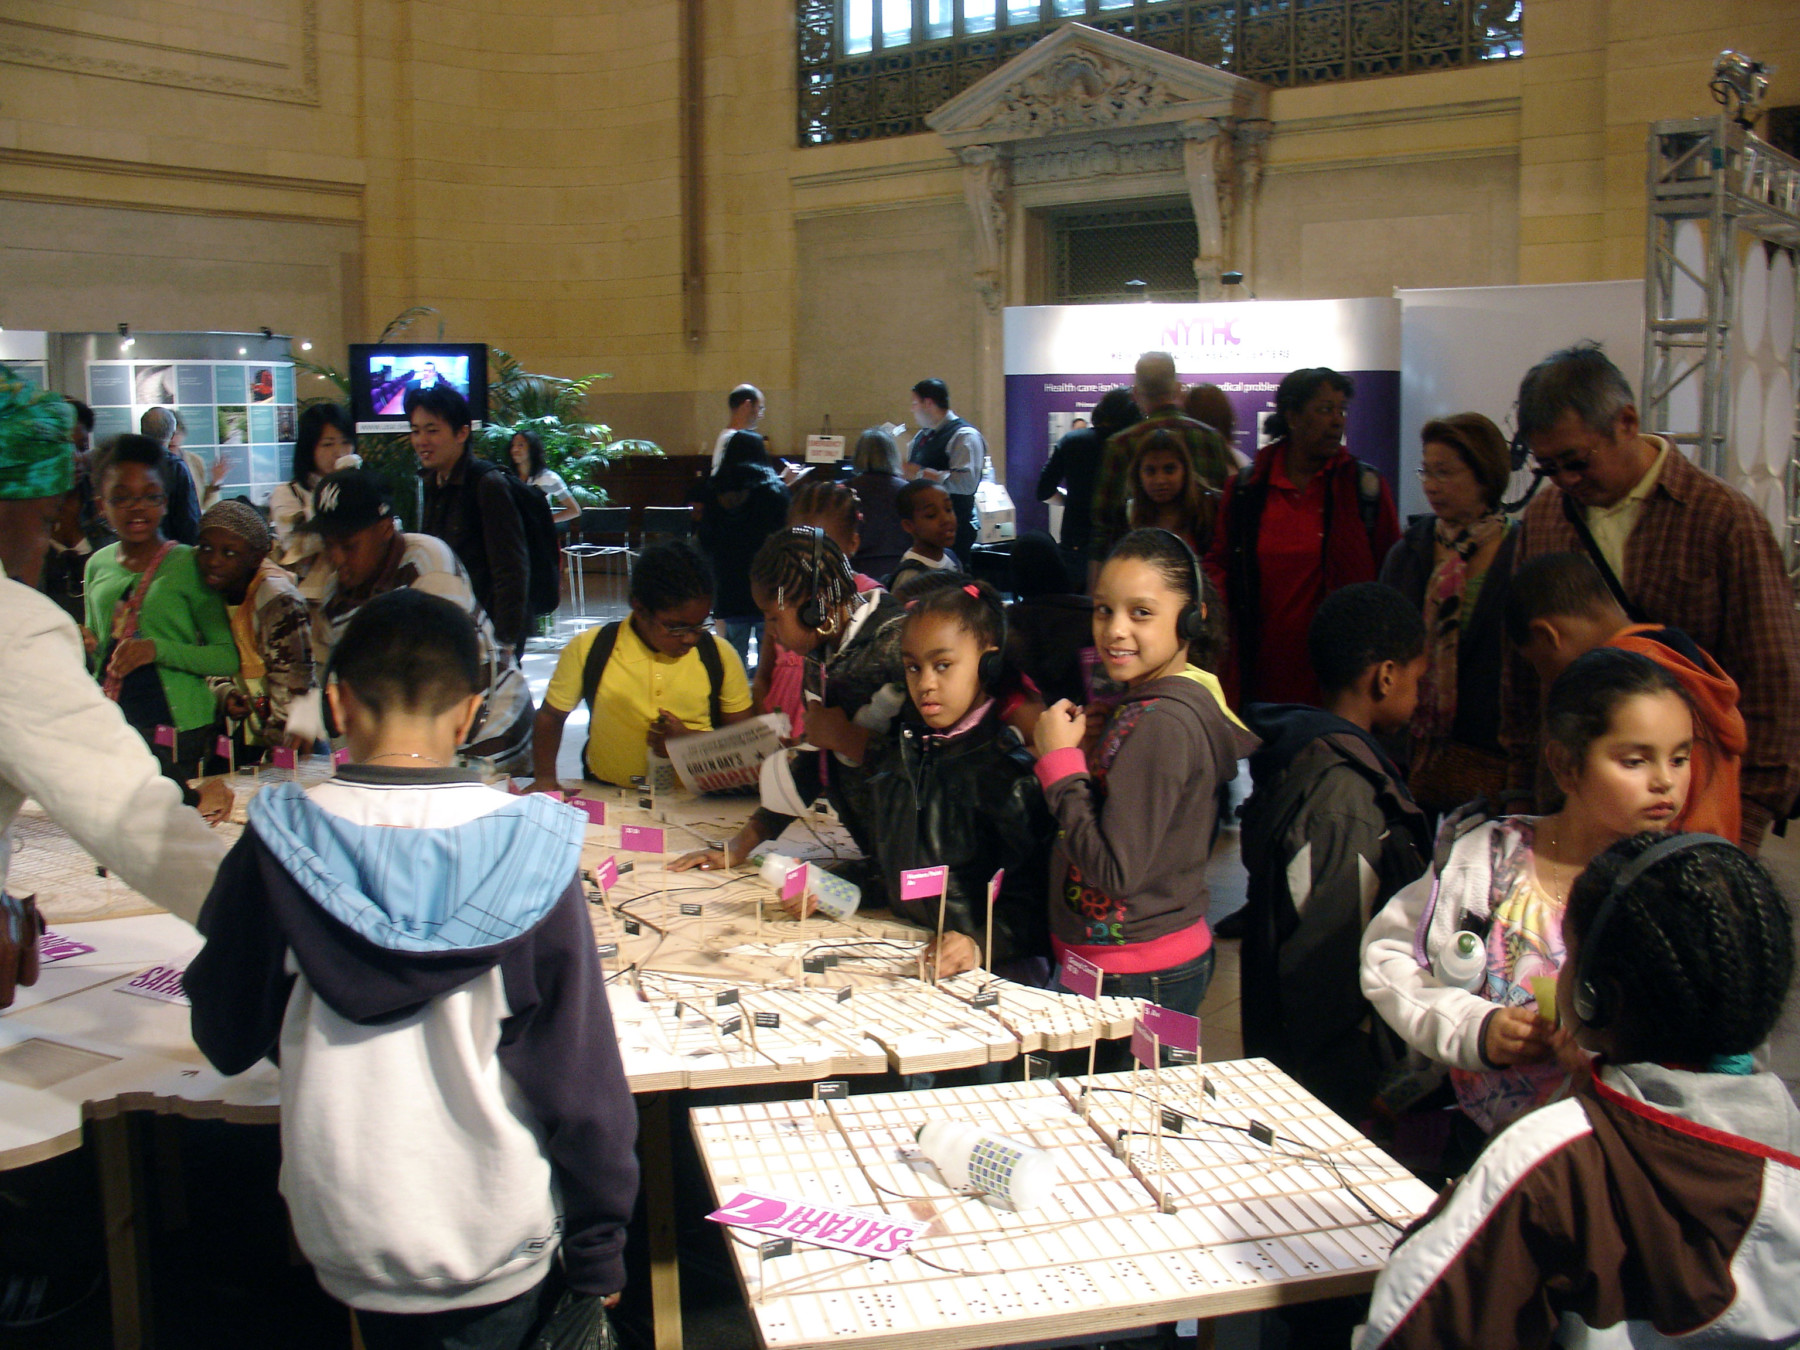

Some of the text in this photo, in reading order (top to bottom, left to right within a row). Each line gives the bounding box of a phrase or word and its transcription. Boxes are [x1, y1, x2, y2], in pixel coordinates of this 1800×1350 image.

[1043, 383, 1076, 392] Health
[128, 966, 189, 998] SAFA
[721, 1198, 915, 1252] SAFARI 7
